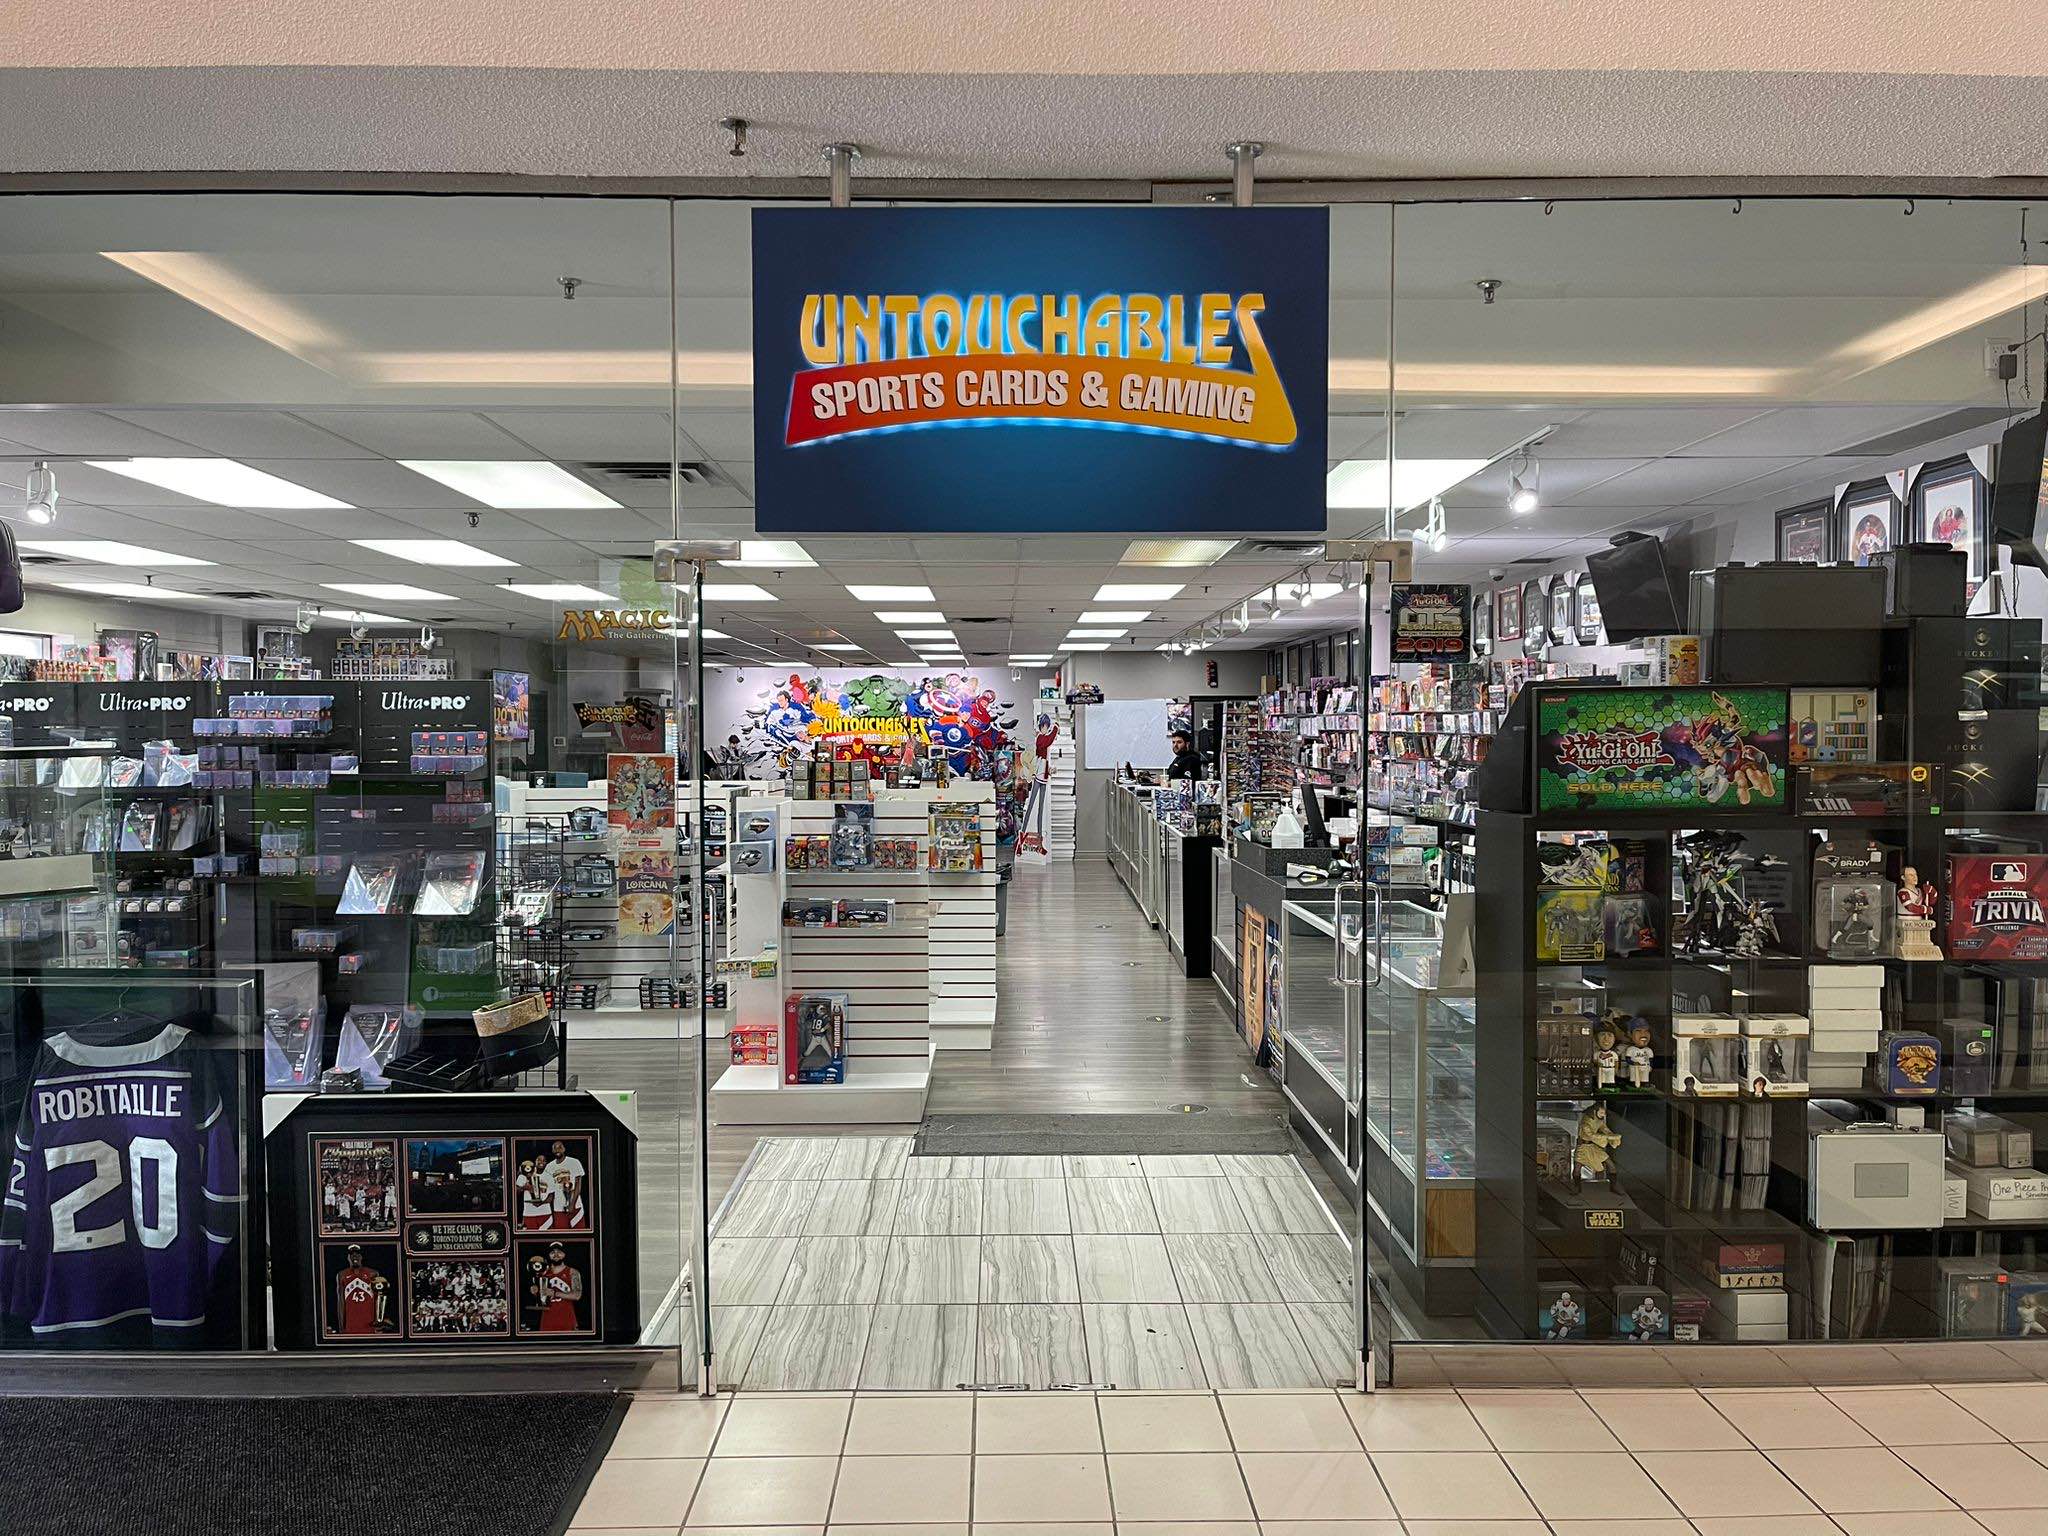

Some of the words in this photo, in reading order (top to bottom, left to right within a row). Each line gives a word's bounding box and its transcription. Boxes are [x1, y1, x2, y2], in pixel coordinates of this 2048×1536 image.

[799, 292, 1268, 370] UNTOUCHABLES
[811, 372, 944, 421] SPORTS
[956, 368, 1068, 408] CARDS
[1079, 373, 1109, 409] &
[1120, 374, 1256, 424] GAMING
[608, 631, 623, 639] The
[1396, 638, 1464, 652] 2019
[1567, 783, 1612, 793] SOLD
[1619, 782, 1663, 792] HERE
[626, 880, 668, 890] LORCANA
[1973, 900, 2045, 924] TRIVIA
[812, 1018, 823, 1030] 18
[38, 1083, 183, 1124] ROBITAILLE
[44, 1136, 179, 1254] 20
[1993, 1182, 2012, 1196] One
[1590, 1212, 1618, 1220] STAR
[1588, 1219, 1620, 1227] WARS
[432, 1225, 442, 1234] WE
[443, 1225, 455, 1234] THE
[456, 1225, 482, 1234] CHAMPS
[352, 1291, 365, 1302] 43
